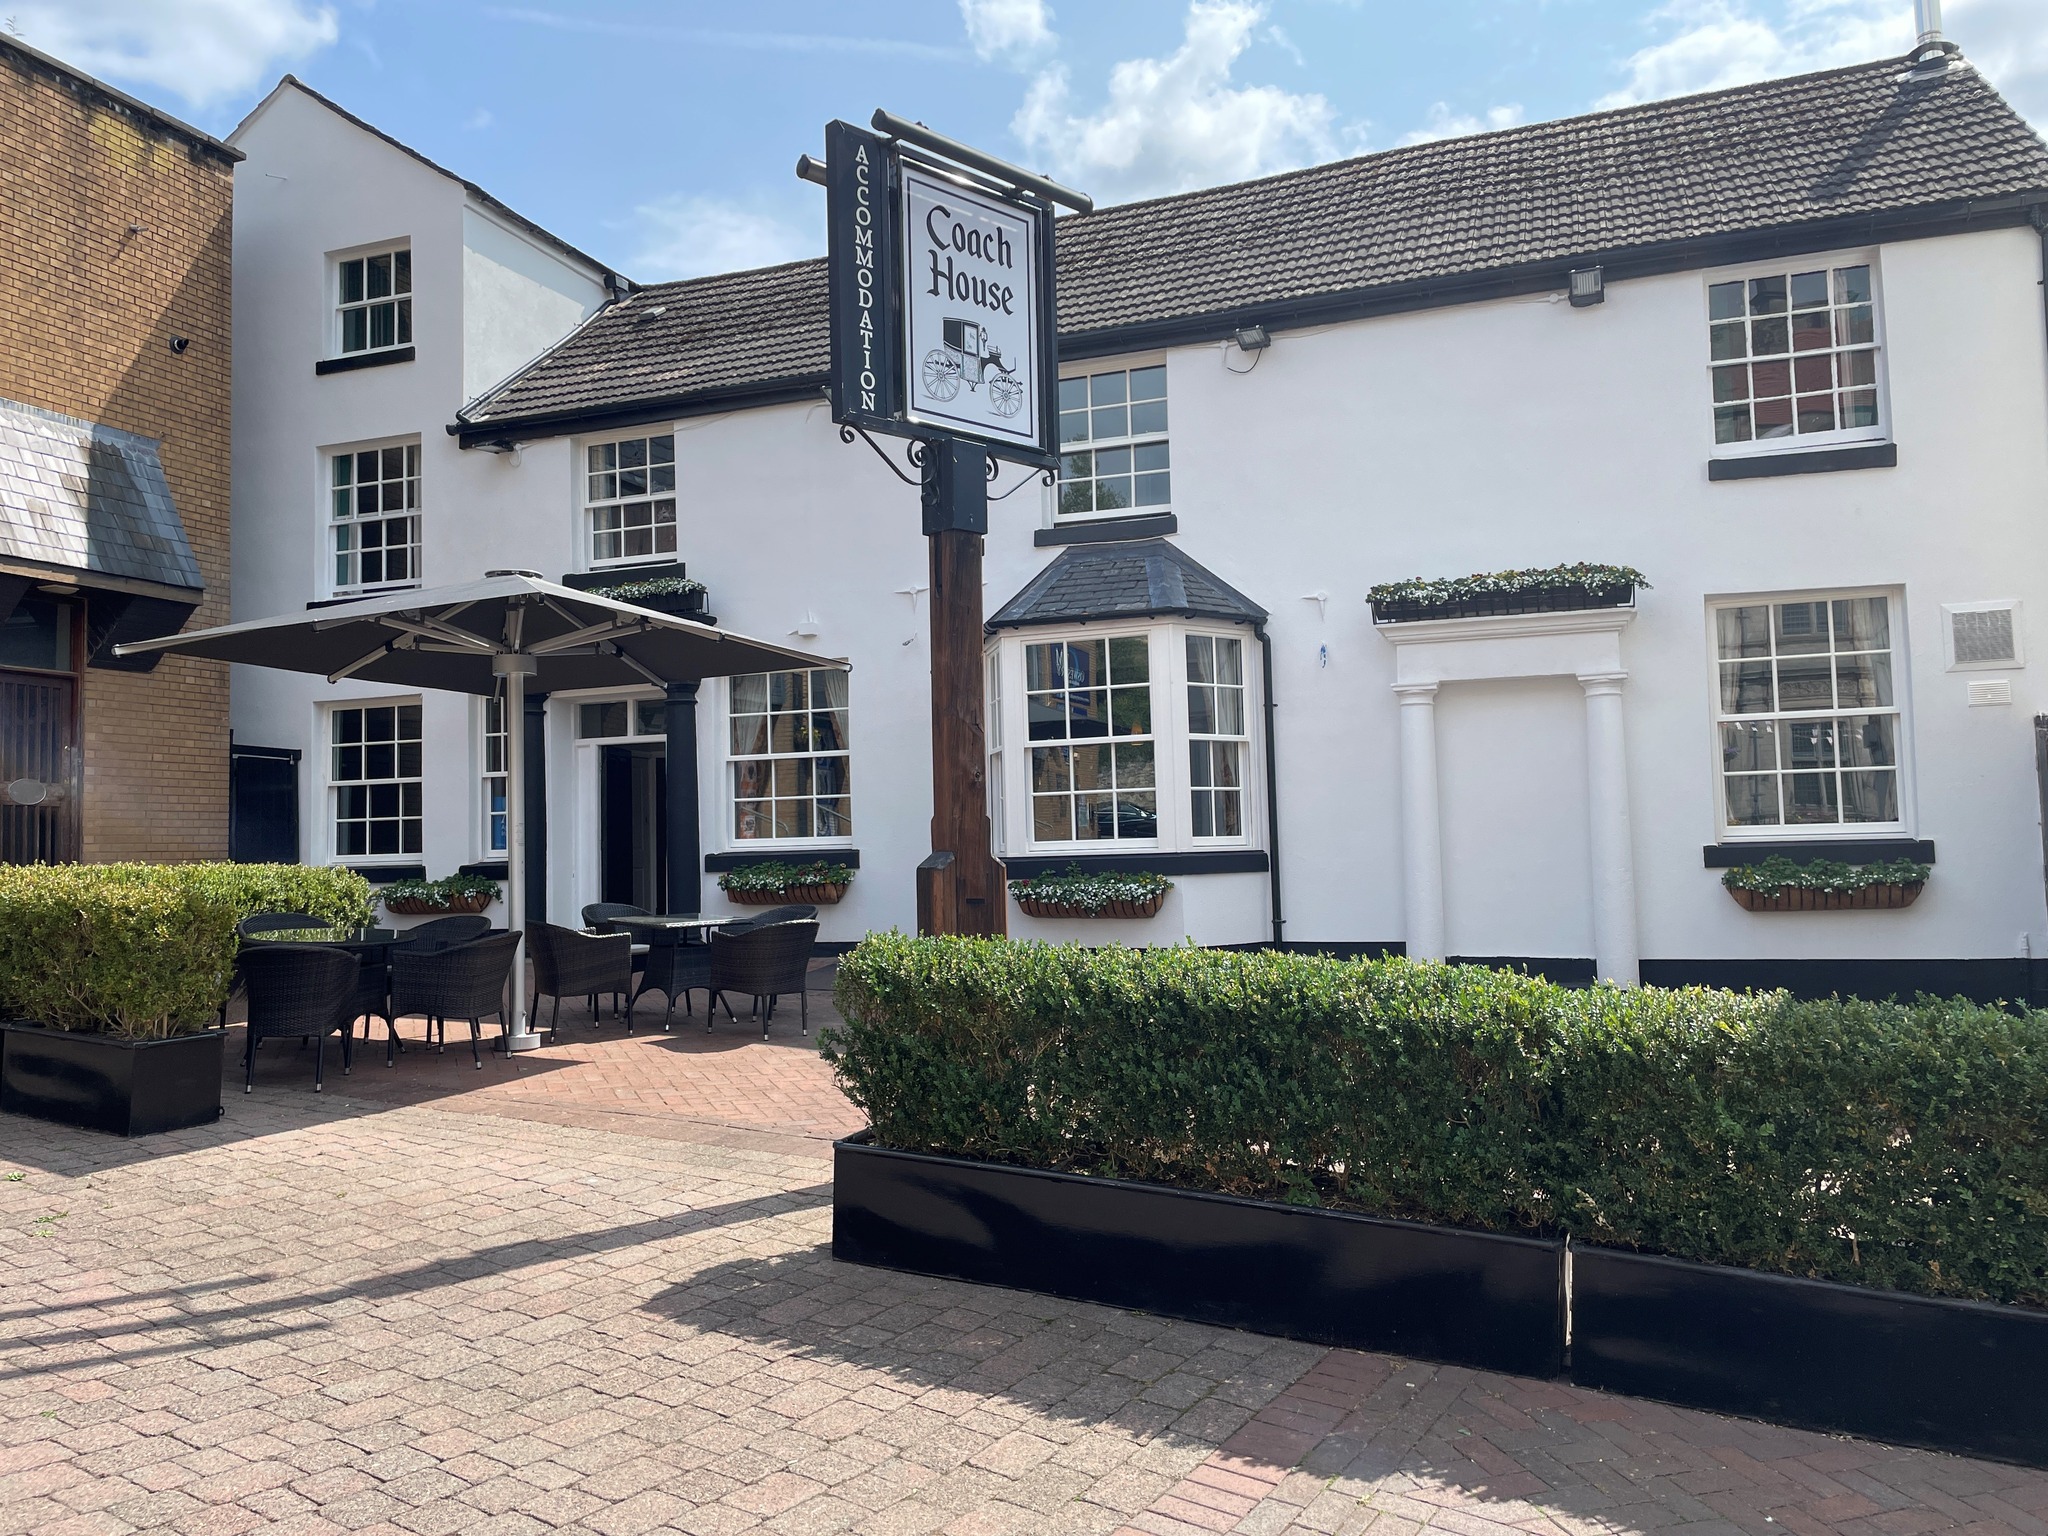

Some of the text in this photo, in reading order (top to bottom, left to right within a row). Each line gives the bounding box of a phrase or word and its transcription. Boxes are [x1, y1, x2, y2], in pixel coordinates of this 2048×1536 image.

[926, 205, 1013, 269] Coach
[855, 145, 876, 411] ACCOMMODATION
[927, 249, 1014, 315] House
